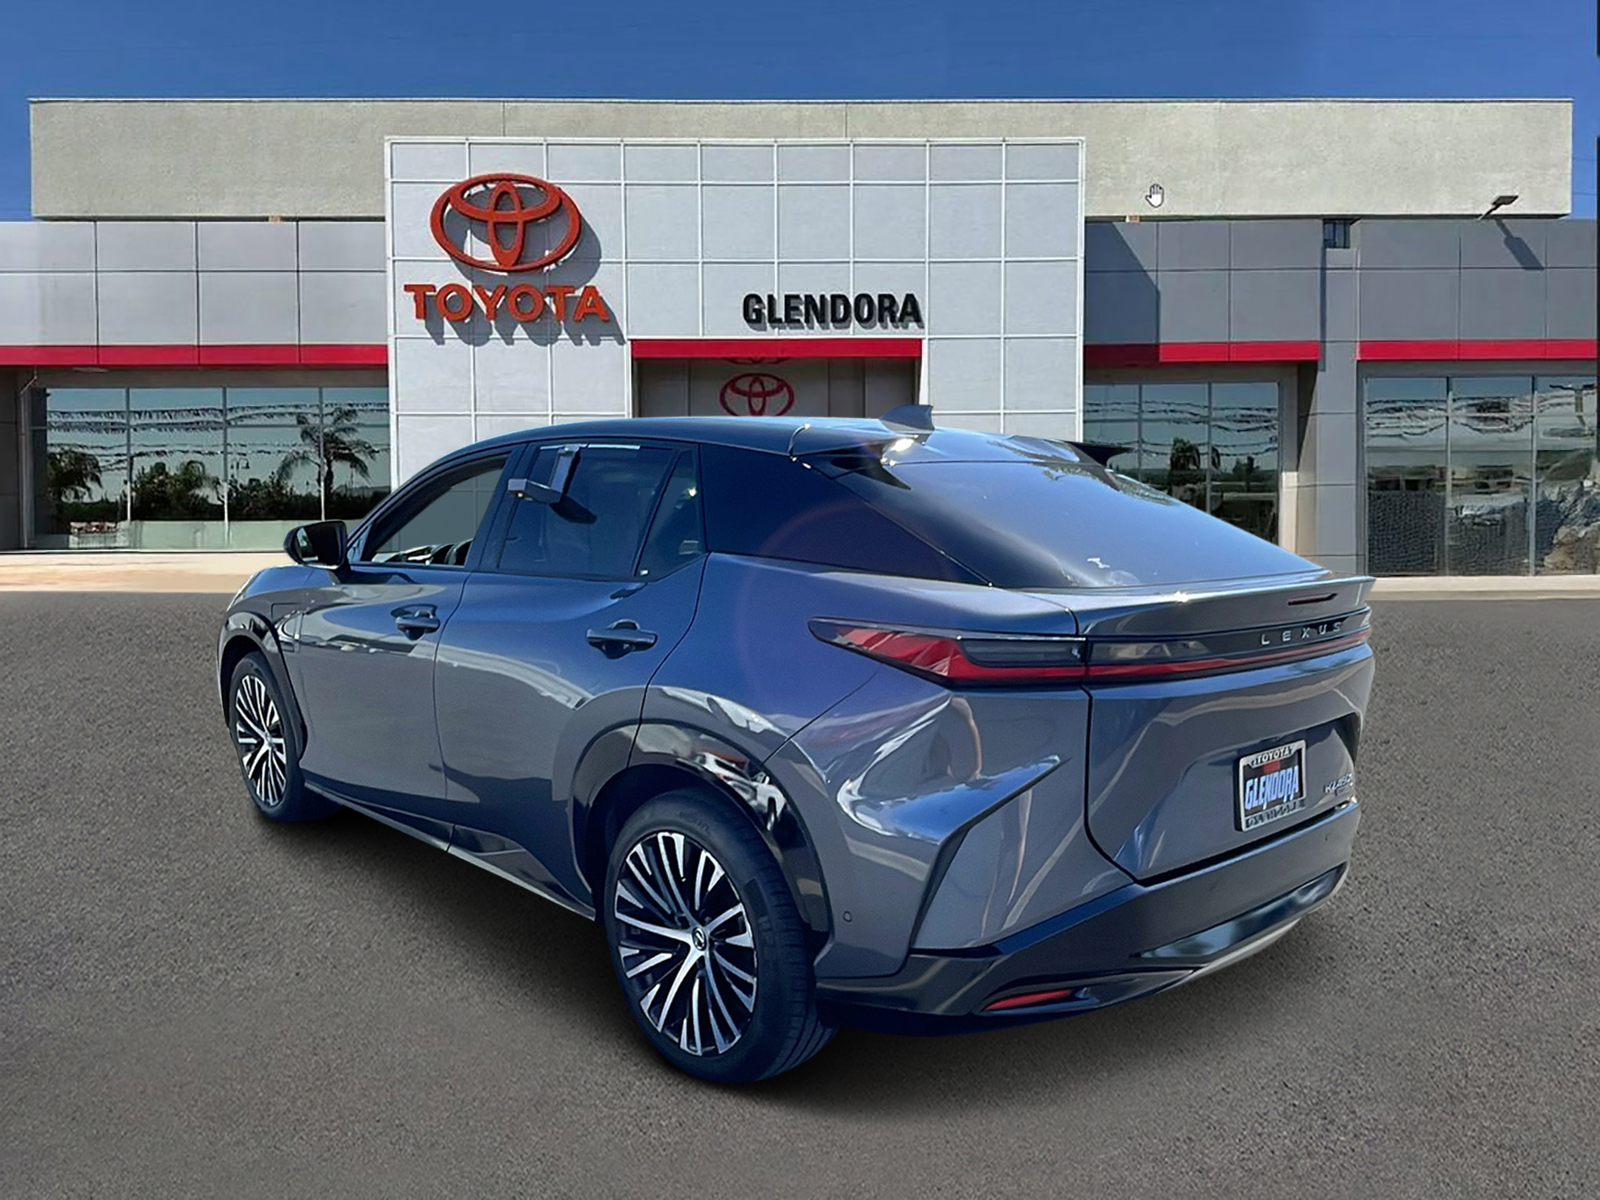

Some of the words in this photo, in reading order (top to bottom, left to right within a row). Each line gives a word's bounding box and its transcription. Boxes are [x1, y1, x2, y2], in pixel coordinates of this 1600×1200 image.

[404, 283, 610, 322] TOYOTA
[743, 293, 922, 325] GLENDORA
[1261, 622, 1342, 645] LEXUS
[1256, 746, 1292, 764] TOYOTA
[1245, 765, 1299, 810] GLENDORA
